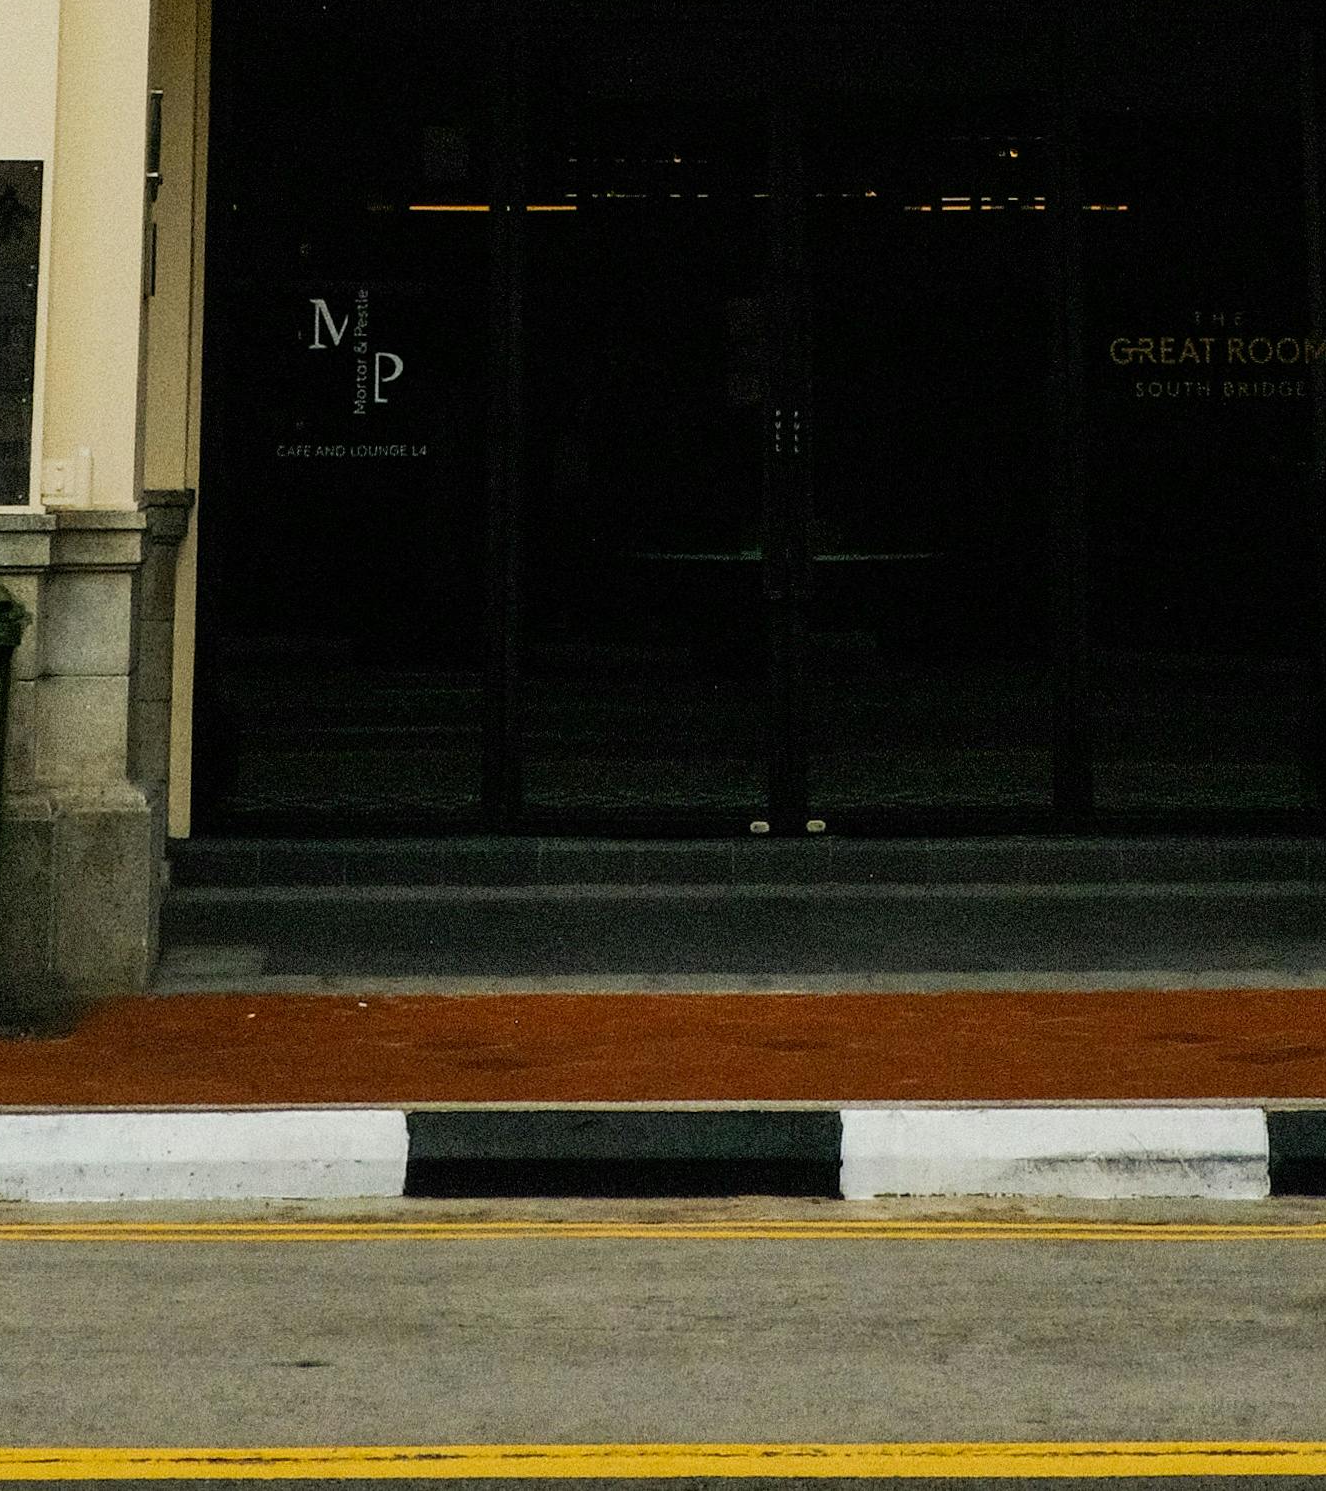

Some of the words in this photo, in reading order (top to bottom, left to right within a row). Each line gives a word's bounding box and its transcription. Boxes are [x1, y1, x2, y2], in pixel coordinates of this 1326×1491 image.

[354, 289, 369, 337] Pestle
[1193, 311, 1245, 327] THE
[353, 341, 367, 355] &
[1109, 336, 1215, 366] GREAT
[353, 358, 367, 415] Mortar
[1134, 381, 1212, 399] SOUTH
[1222, 381, 1306, 399] BRIDGE
[276, 444, 311, 457] CAFE
[315, 444, 346, 457] AND
[350, 444, 407, 457] LOUNGE
